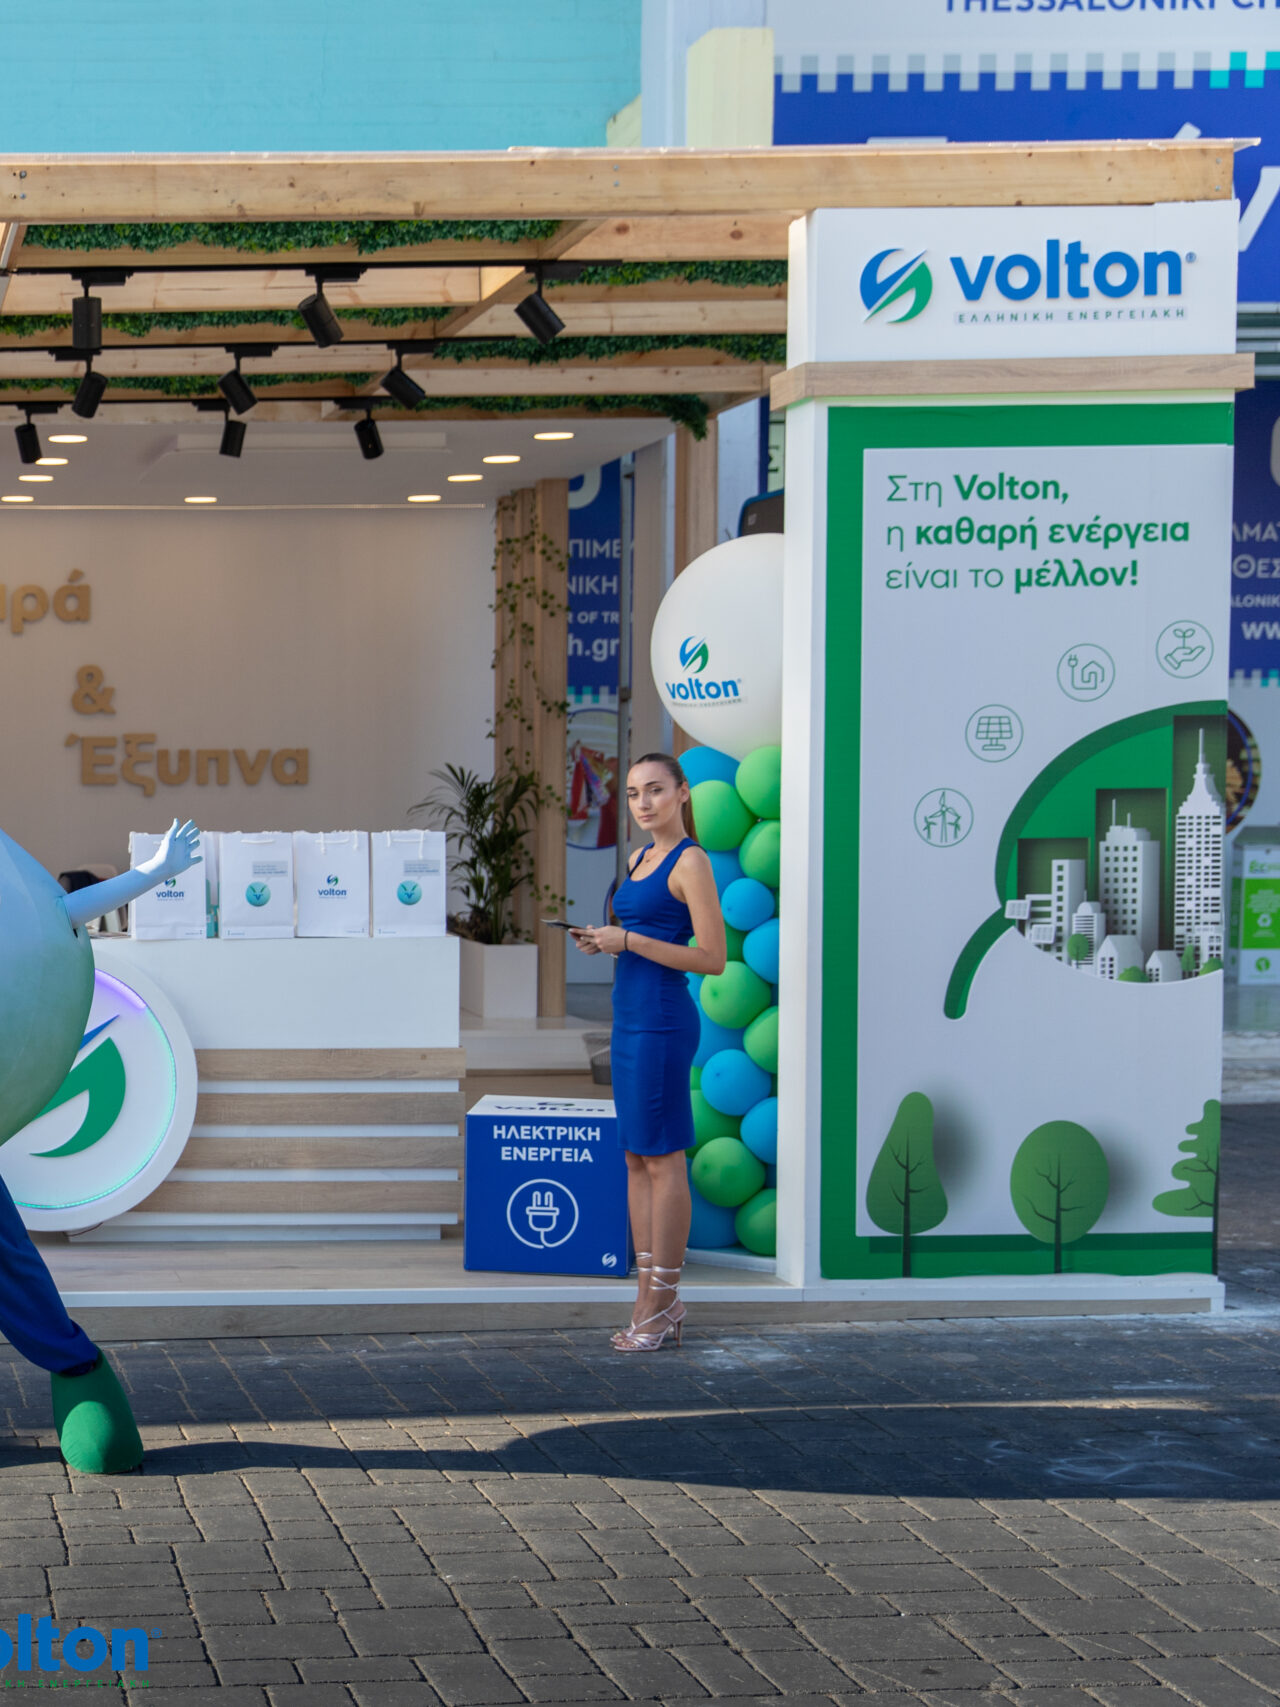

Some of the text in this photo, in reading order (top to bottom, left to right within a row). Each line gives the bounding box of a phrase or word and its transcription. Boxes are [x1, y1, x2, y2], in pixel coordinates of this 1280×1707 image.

[959, 309, 1185, 324] ΕΛΛΗΝΙΚΗ ΕΝΕΡΓΕΙΑΚΗ
[886, 472, 1069, 507] Στη Volton,
[887, 515, 1189, 552] η καθαρή ενέργεια
[886, 559, 1138, 594] είναι το μέλλον!
[71, 664, 116, 715] &
[64, 732, 309, 797] Έξυπνα
[156, 890, 184, 898] volton
[318, 888, 347, 897] volton
[493, 1125, 601, 1142] ΗΛΕΚΤΡΙΚΗ
[501, 1146, 593, 1163] ΕΝΕΡΓΕΙΑ
